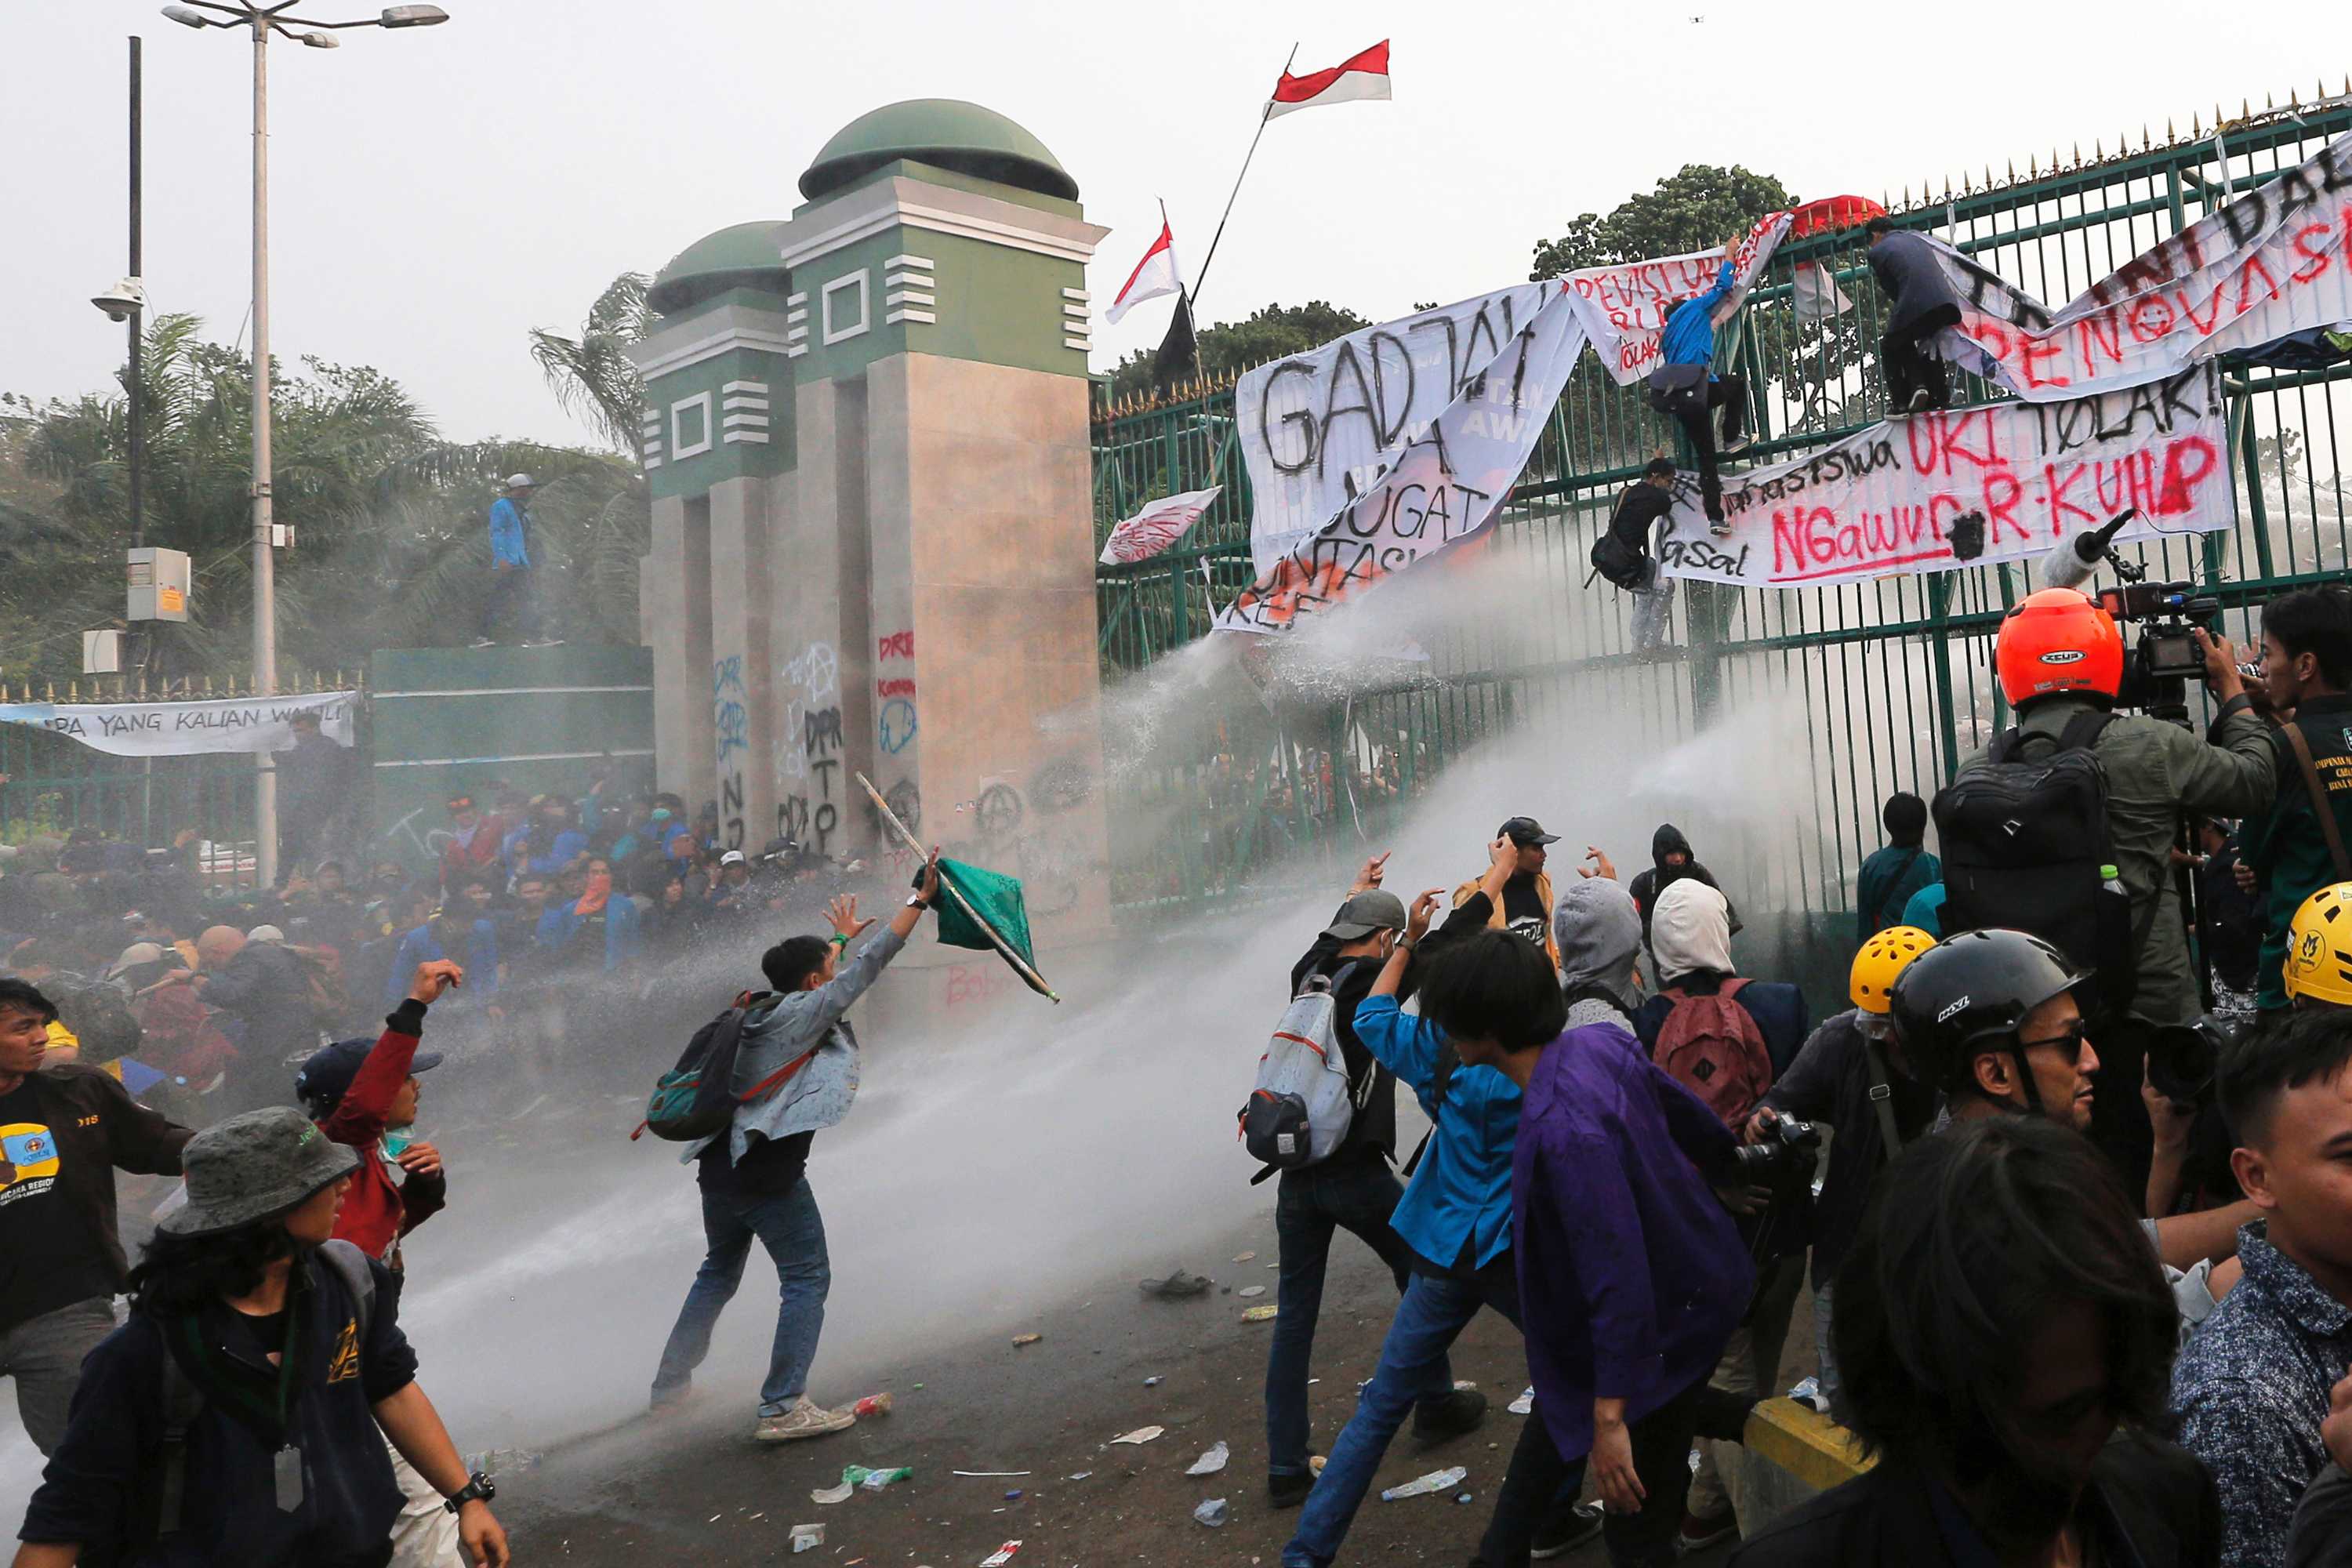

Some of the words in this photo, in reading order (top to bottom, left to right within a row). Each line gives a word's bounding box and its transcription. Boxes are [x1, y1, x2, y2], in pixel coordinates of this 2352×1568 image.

[1908, 407, 2009, 476] UKI
[98, 712, 162, 737] YANG
[176, 708, 260, 731] KALIAN
